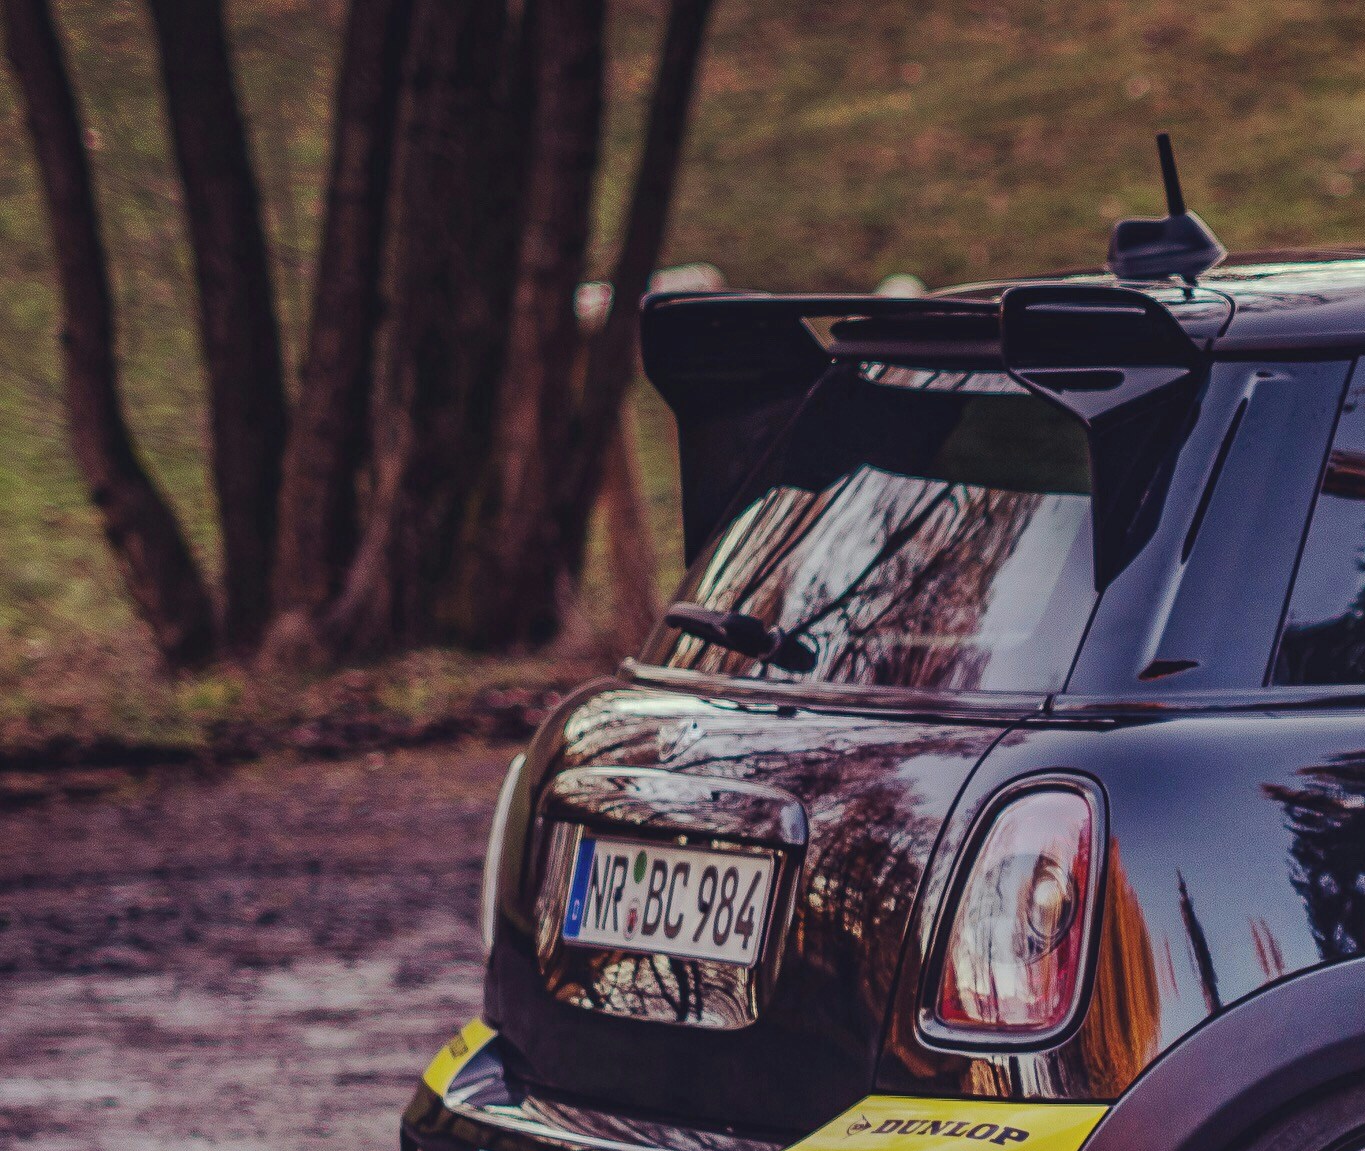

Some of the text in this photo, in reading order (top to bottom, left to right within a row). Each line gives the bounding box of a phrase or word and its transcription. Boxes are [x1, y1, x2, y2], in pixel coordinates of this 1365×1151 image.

[583, 855, 762, 950] NR BC 984
[871, 1119, 1030, 1146] DUNLOP
